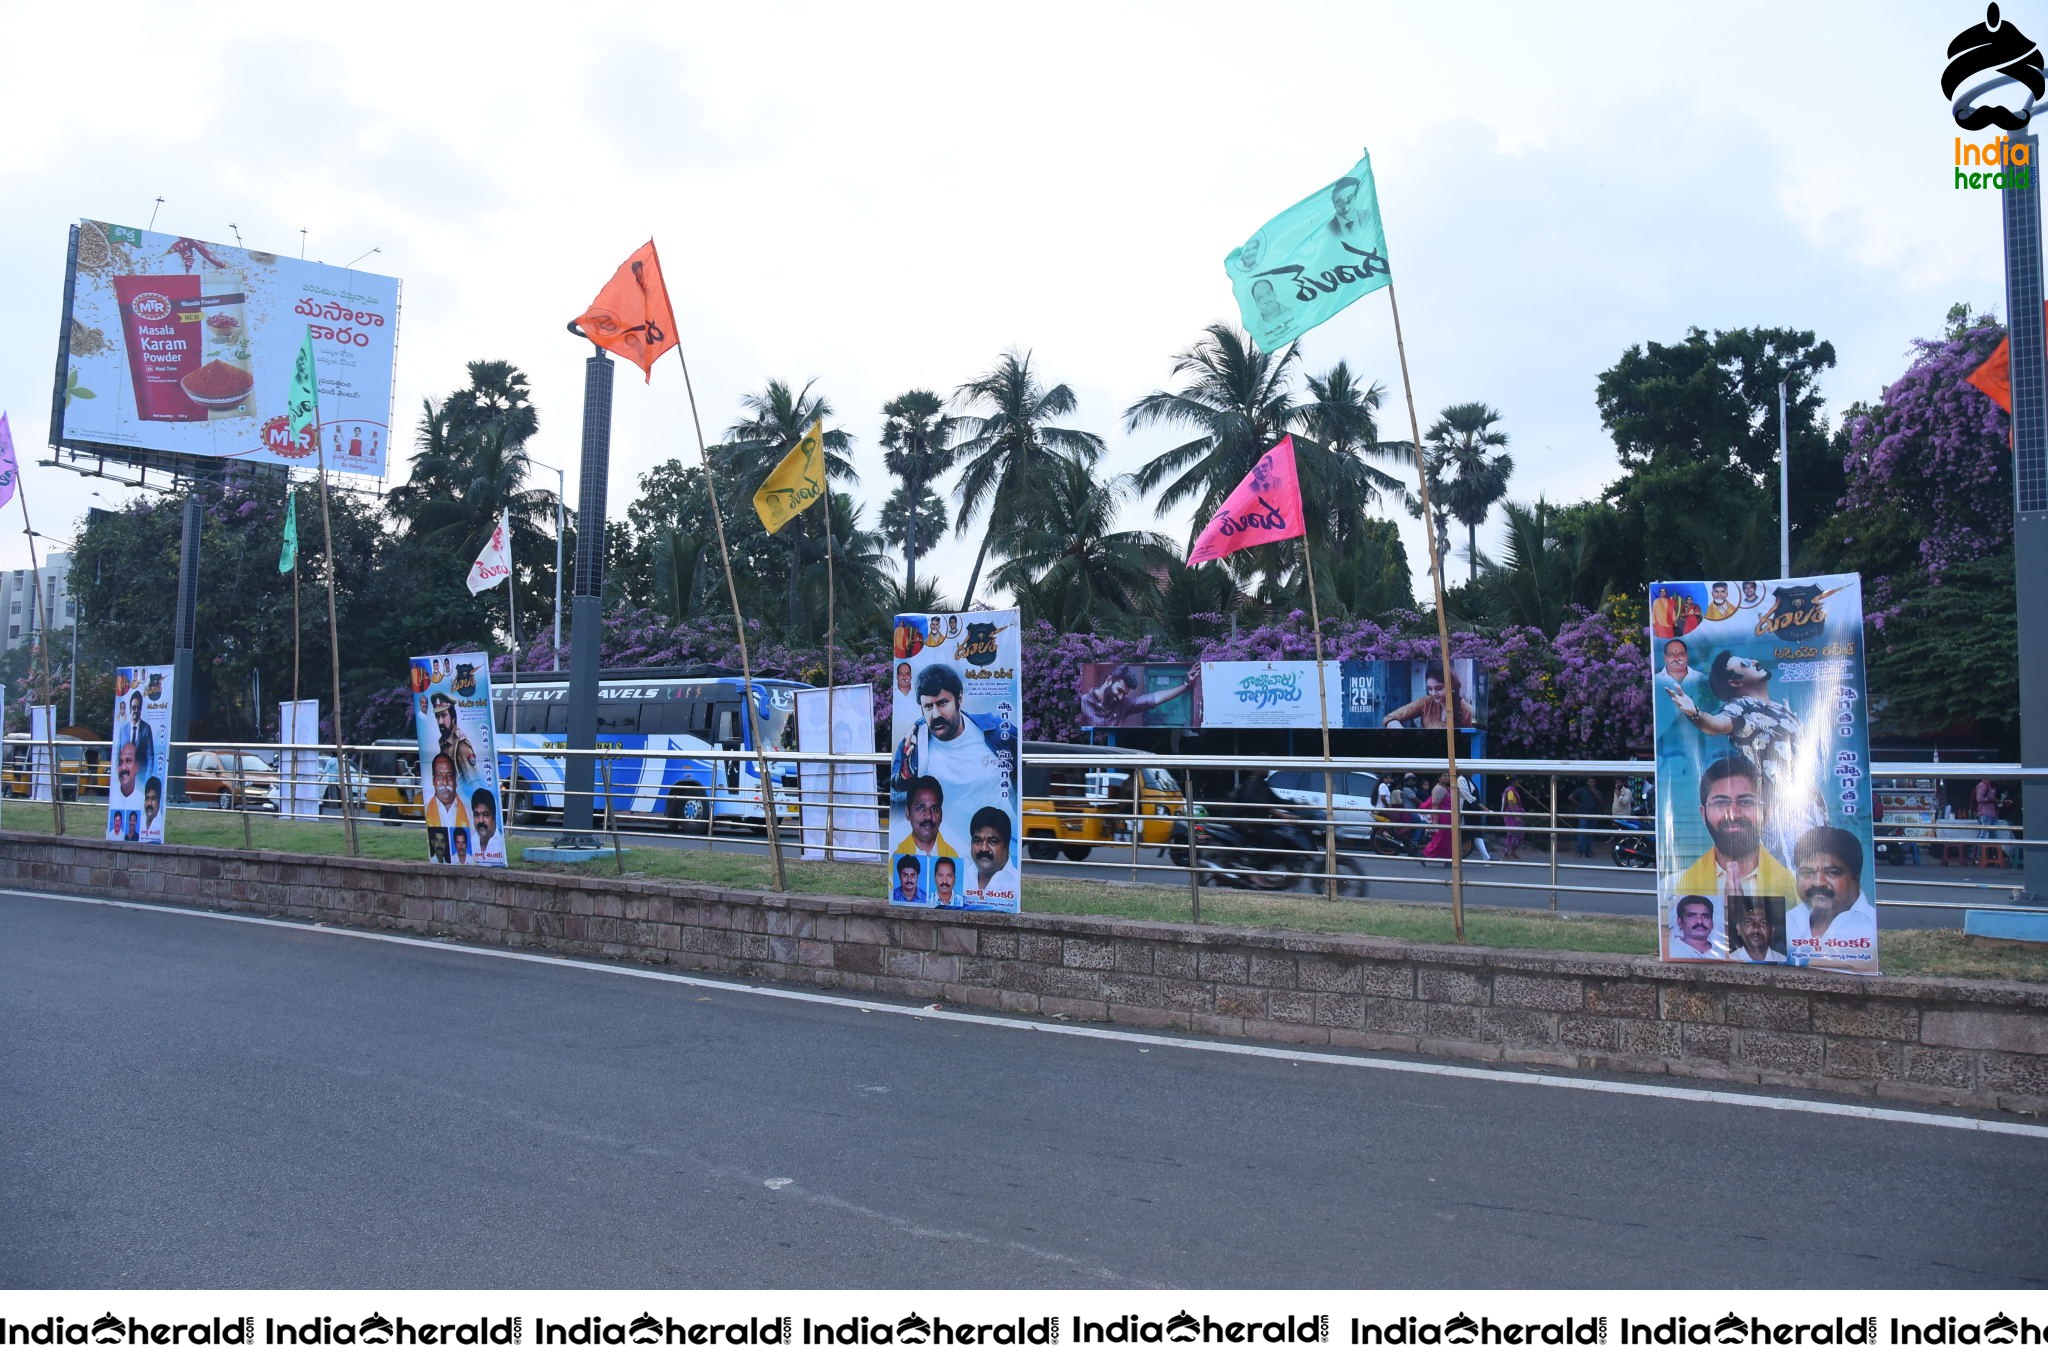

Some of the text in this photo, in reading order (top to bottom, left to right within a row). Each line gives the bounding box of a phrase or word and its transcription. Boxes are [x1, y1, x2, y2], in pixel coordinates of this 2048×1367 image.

[140, 299, 164, 313] MTR
[294, 297, 385, 327] మసాలా
[139, 325, 175, 336] Masala
[307, 323, 369, 347] కారం
[141, 338, 187, 351] Karam
[143, 352, 182, 363] Powder
[1351, 676, 1373, 688] NOV
[521, 690, 568, 700] SLVT
[1352, 687, 1368, 706] 29
[1824, 937, 1871, 949] శంకర్
